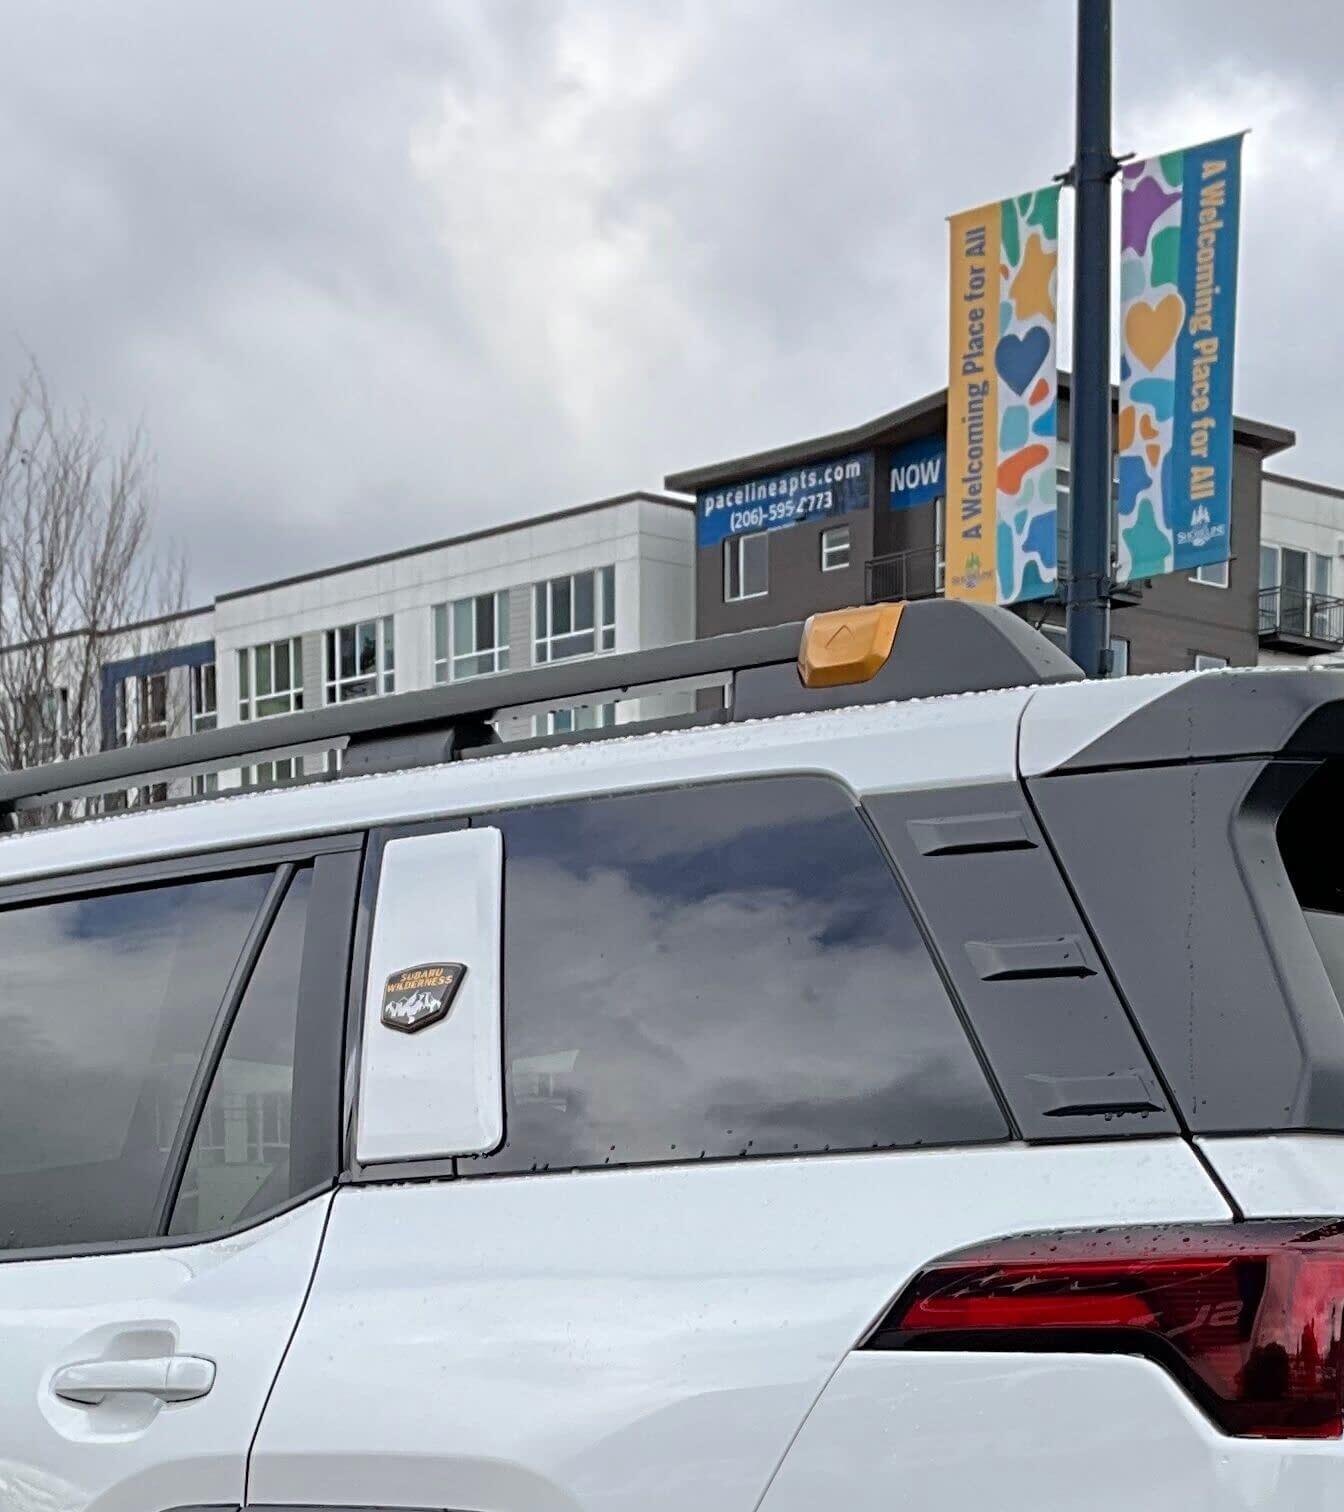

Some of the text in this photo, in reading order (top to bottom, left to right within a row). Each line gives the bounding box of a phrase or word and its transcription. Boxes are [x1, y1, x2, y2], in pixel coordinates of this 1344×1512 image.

[1189, 160, 1227, 500] A Welcoming Place for All
[961, 224, 990, 539] A Welcoming Place for All
[704, 460, 862, 517] pacelineapts.com
[889, 458, 942, 493] NOW
[387, 974, 454, 993] WILDERNESS
[400, 967, 444, 982] SUBARU
